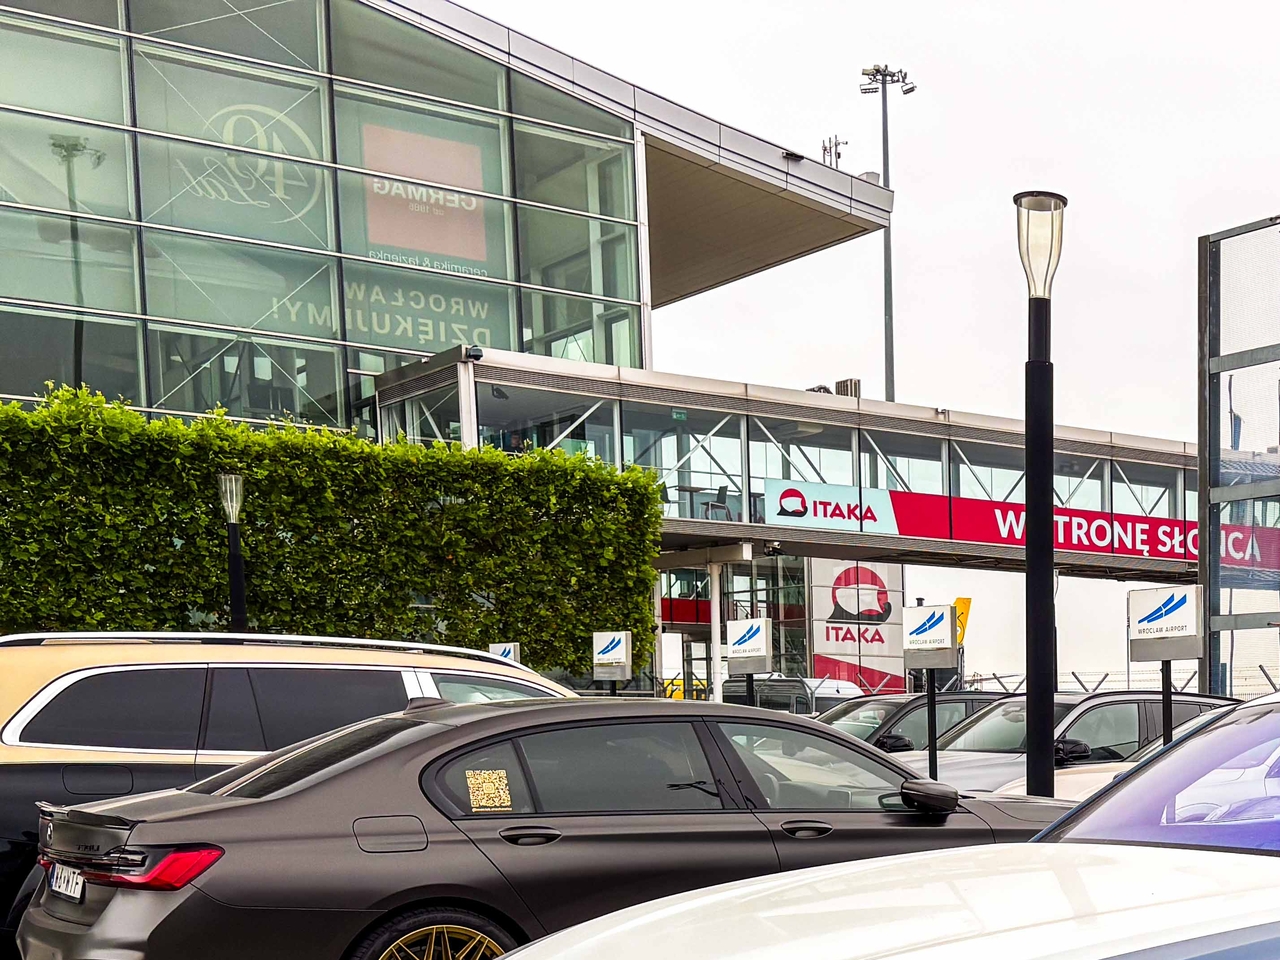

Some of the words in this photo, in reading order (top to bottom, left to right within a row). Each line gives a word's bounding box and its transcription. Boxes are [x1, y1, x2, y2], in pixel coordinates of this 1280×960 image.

[812, 500, 878, 523] ITAKA
[994, 508, 1027, 541] W
[1053, 514, 1151, 557] TRONĘ
[825, 626, 885, 644] ITAKA
[1138, 627, 1164, 635] WROCLAW
[1165, 625, 1187, 633] AIRPORT
